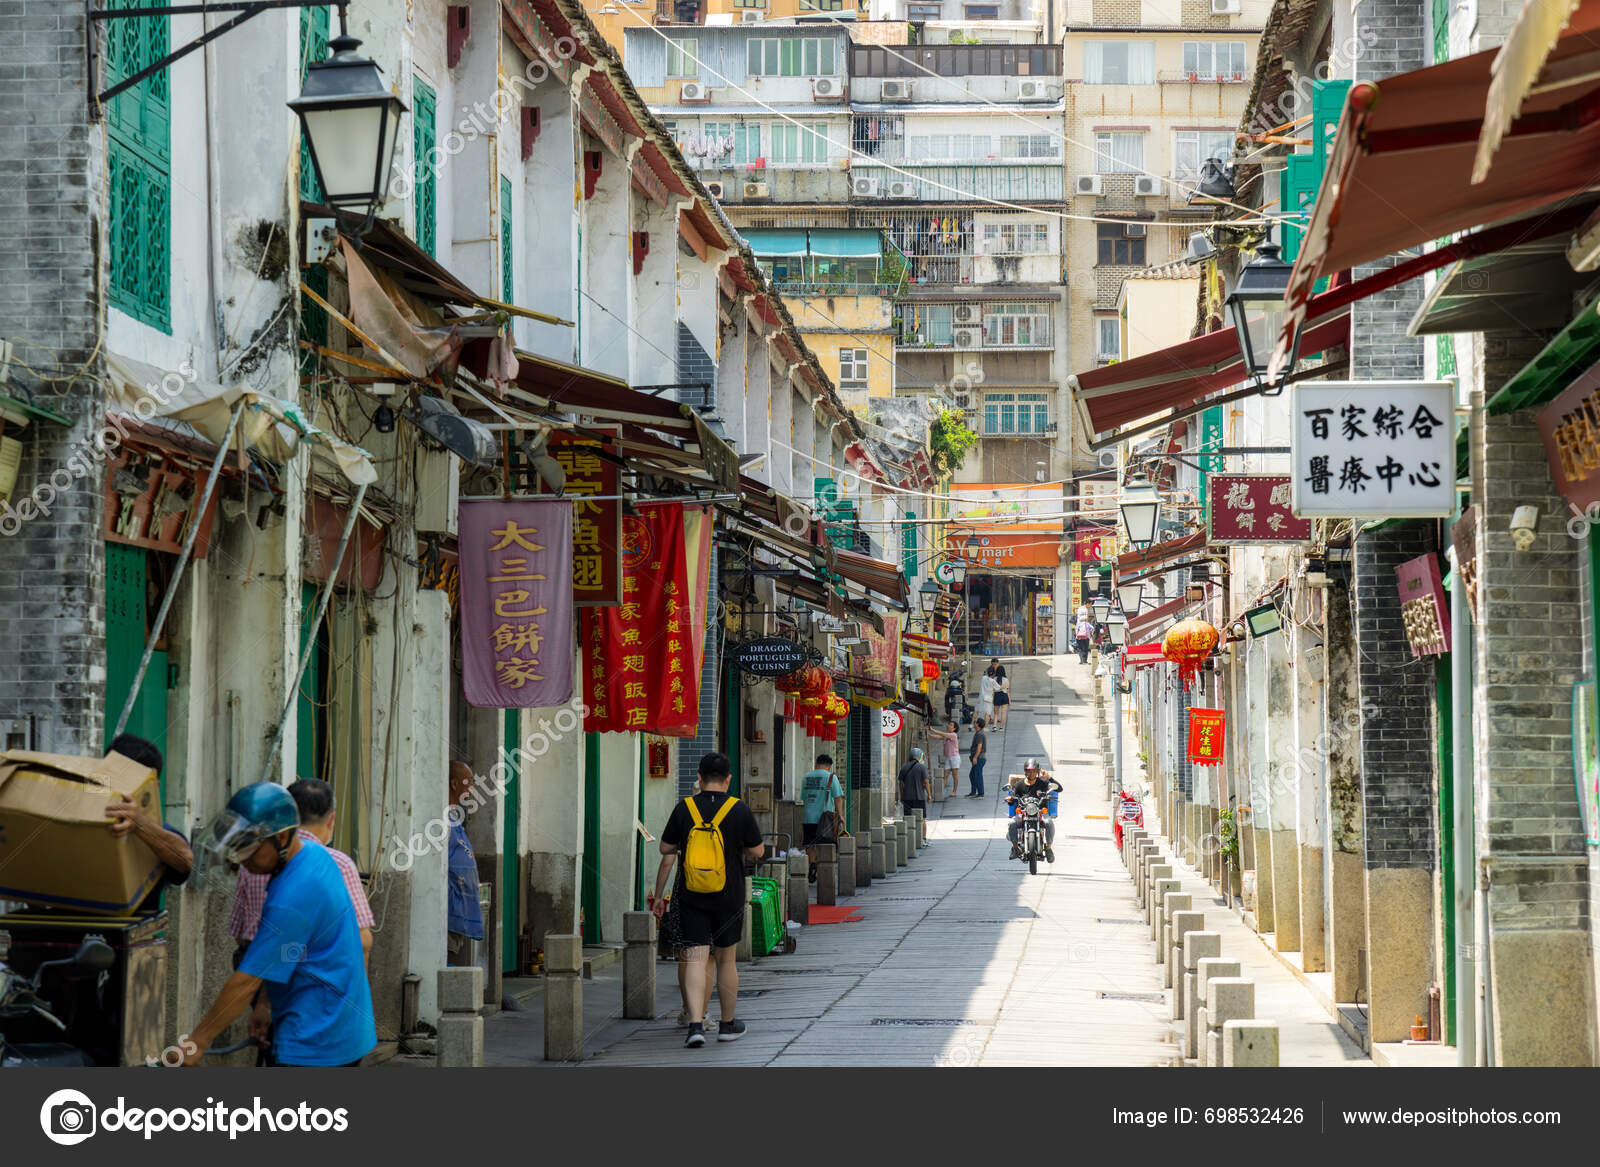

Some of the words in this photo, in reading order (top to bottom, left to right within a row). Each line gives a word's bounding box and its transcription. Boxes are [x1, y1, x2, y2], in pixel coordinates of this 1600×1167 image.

[1304, 404, 1444, 441] 百家綜合
[1304, 455, 1442, 495] 醫療中心
[982, 548, 1014, 557] mart
[487, 520, 548, 690] 大三巴餅家
[750, 645, 791, 653] DRAGON
[739, 654, 803, 662] PORTUGUESE
[751, 663, 791, 671] CUISINE
